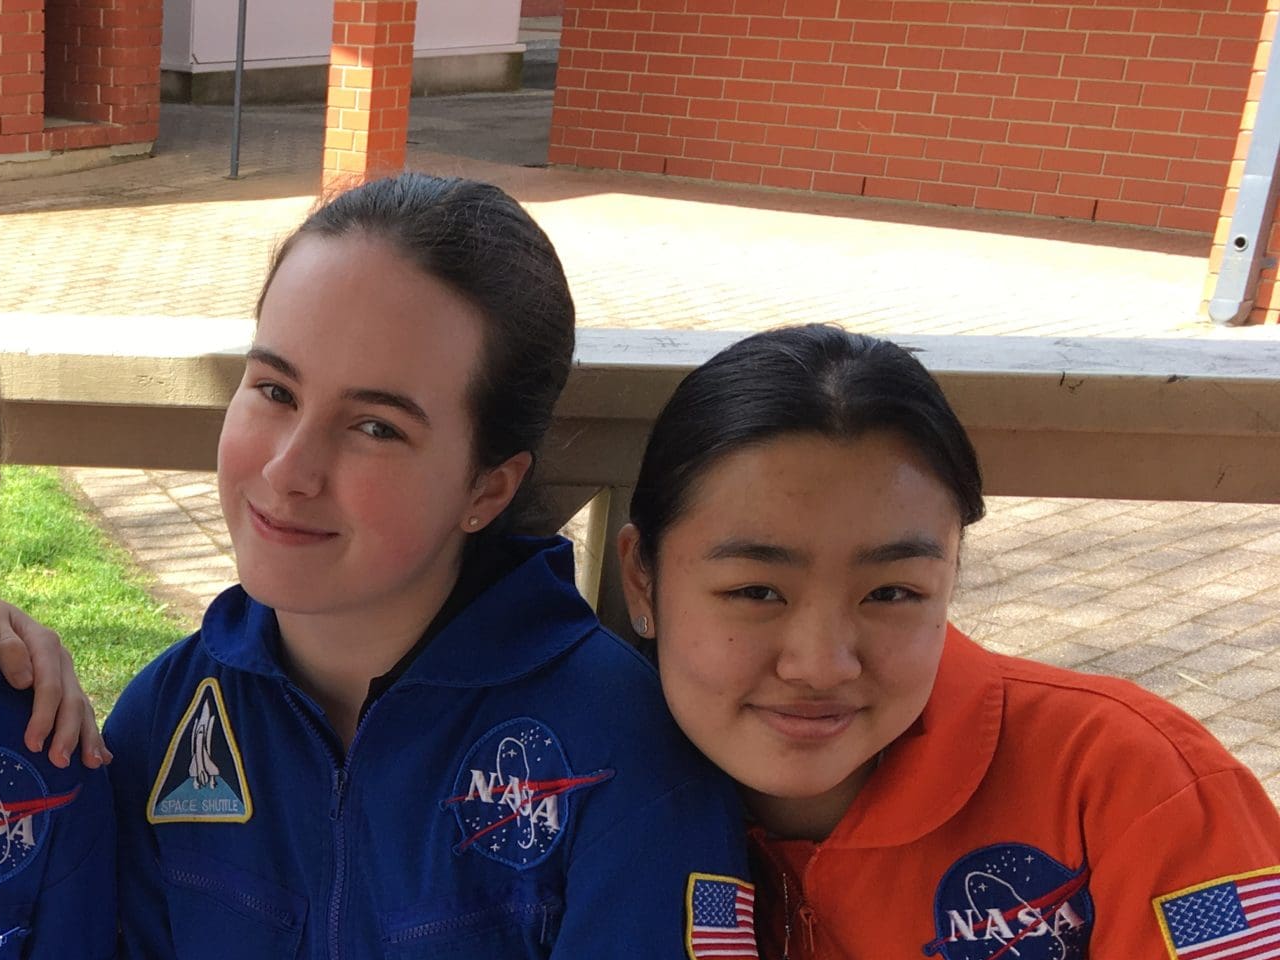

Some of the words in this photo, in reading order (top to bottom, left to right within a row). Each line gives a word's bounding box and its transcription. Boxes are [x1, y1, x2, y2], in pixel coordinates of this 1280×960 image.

[160, 799, 198, 813] SPACE
[202, 799, 239, 812] SHUTTLE
[945, 900, 1086, 943] NASA
